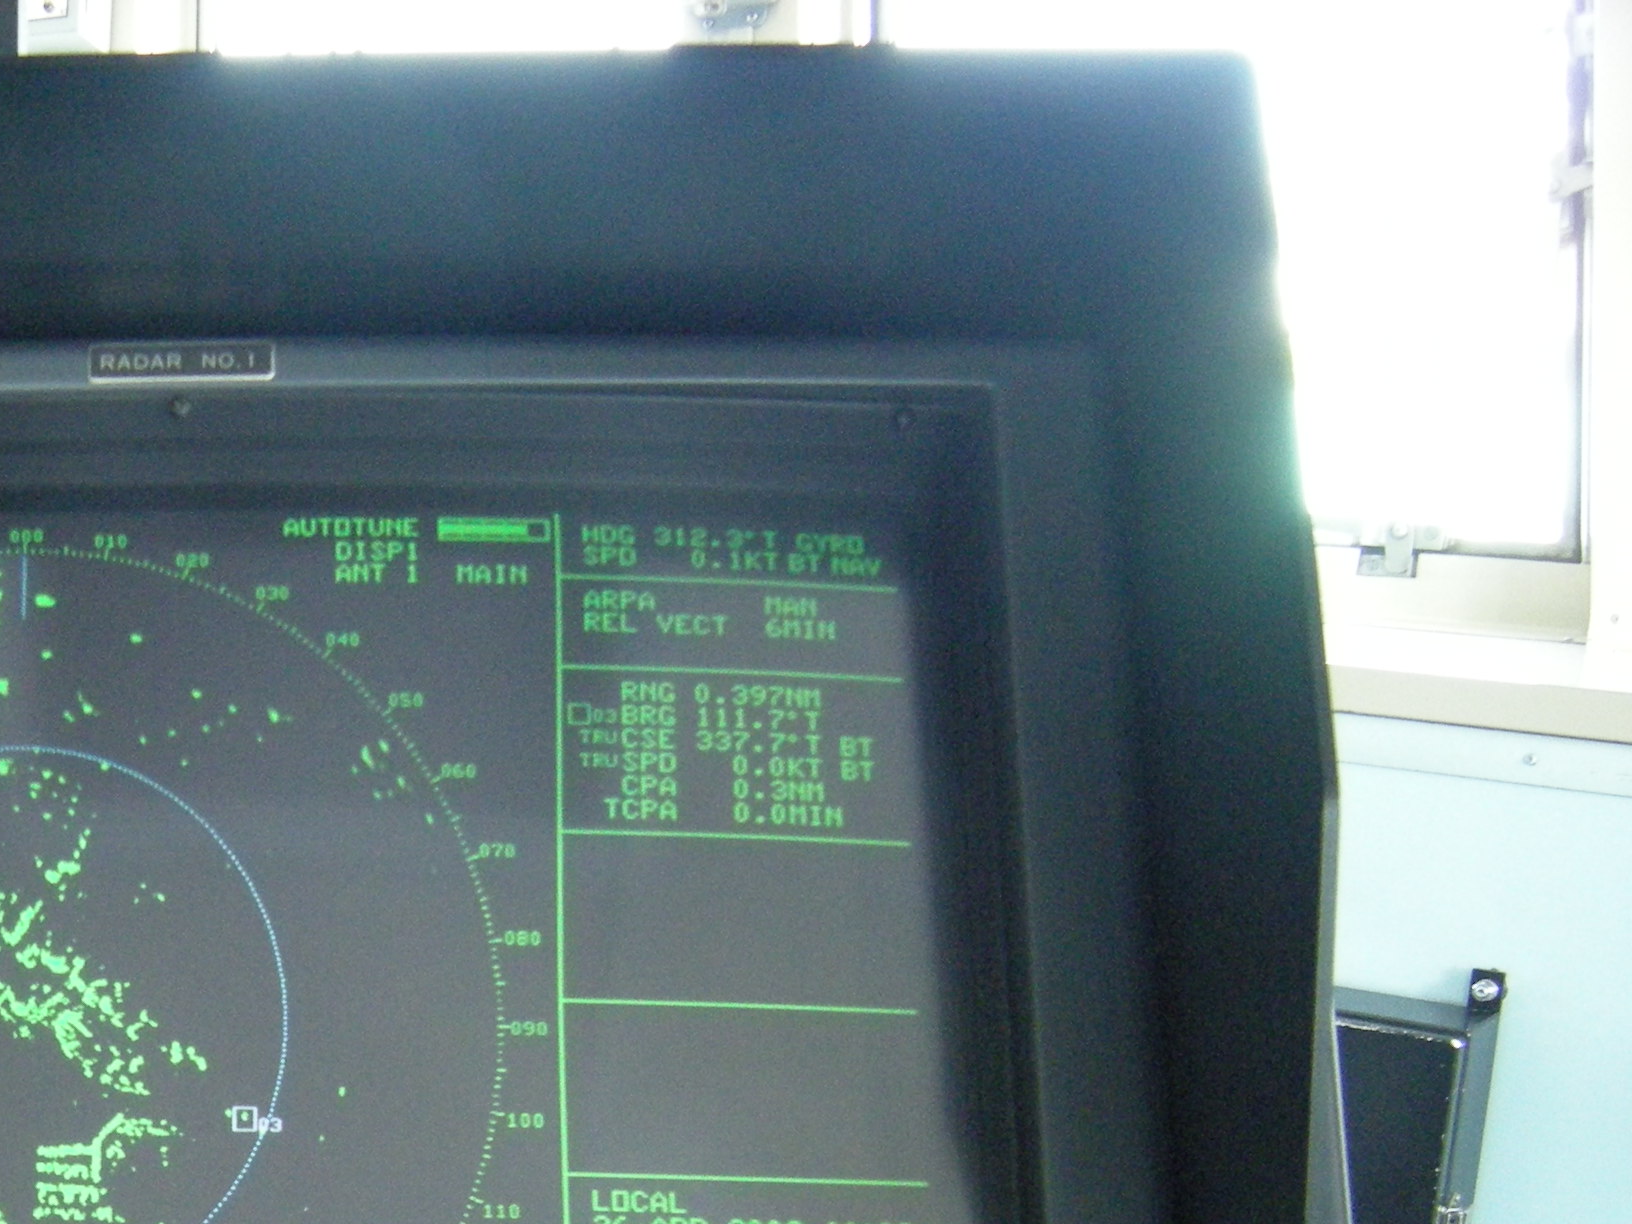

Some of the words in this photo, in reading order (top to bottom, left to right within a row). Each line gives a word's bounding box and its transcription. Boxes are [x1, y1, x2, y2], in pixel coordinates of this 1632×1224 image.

[100, 354, 182, 370] RADAR
[201, 353, 241, 369] NO.
[248, 353, 255, 368] 1
[9, 528, 44, 544] 000
[282, 517, 419, 538] AUTOTUNE
[581, 524, 636, 546] HDG
[94, 533, 128, 550] 010
[334, 540, 419, 562] DISP1
[582, 545, 637, 567] SPD
[690, 549, 777, 572] 0.1KT
[334, 563, 386, 584] ANT
[456, 563, 528, 585] MAIN
[582, 588, 657, 611] ARPA
[583, 611, 638, 634] REL
[655, 614, 728, 636] VECT
[764, 618, 836, 640] 6MIN
[620, 681, 676, 704] RNG
[694, 682, 821, 708] 0.397NM
[620, 704, 677, 727] BRG
[620, 727, 676, 750] CSE
[839, 735, 874, 759] BT
[621, 751, 678, 774] SPD
[732, 754, 824, 779] 0.0KT
[840, 760, 876, 782] BT
[621, 774, 677, 797] CPA
[732, 778, 825, 803] 0.3NM
[603, 797, 678, 821] TCPA
[733, 801, 844, 828] 0.0MIN
[509, 1020, 548, 1036] 090
[507, 1112, 544, 1129] 100
[483, 1203, 521, 1219] 110
[591, 1189, 688, 1215] LOCAL
